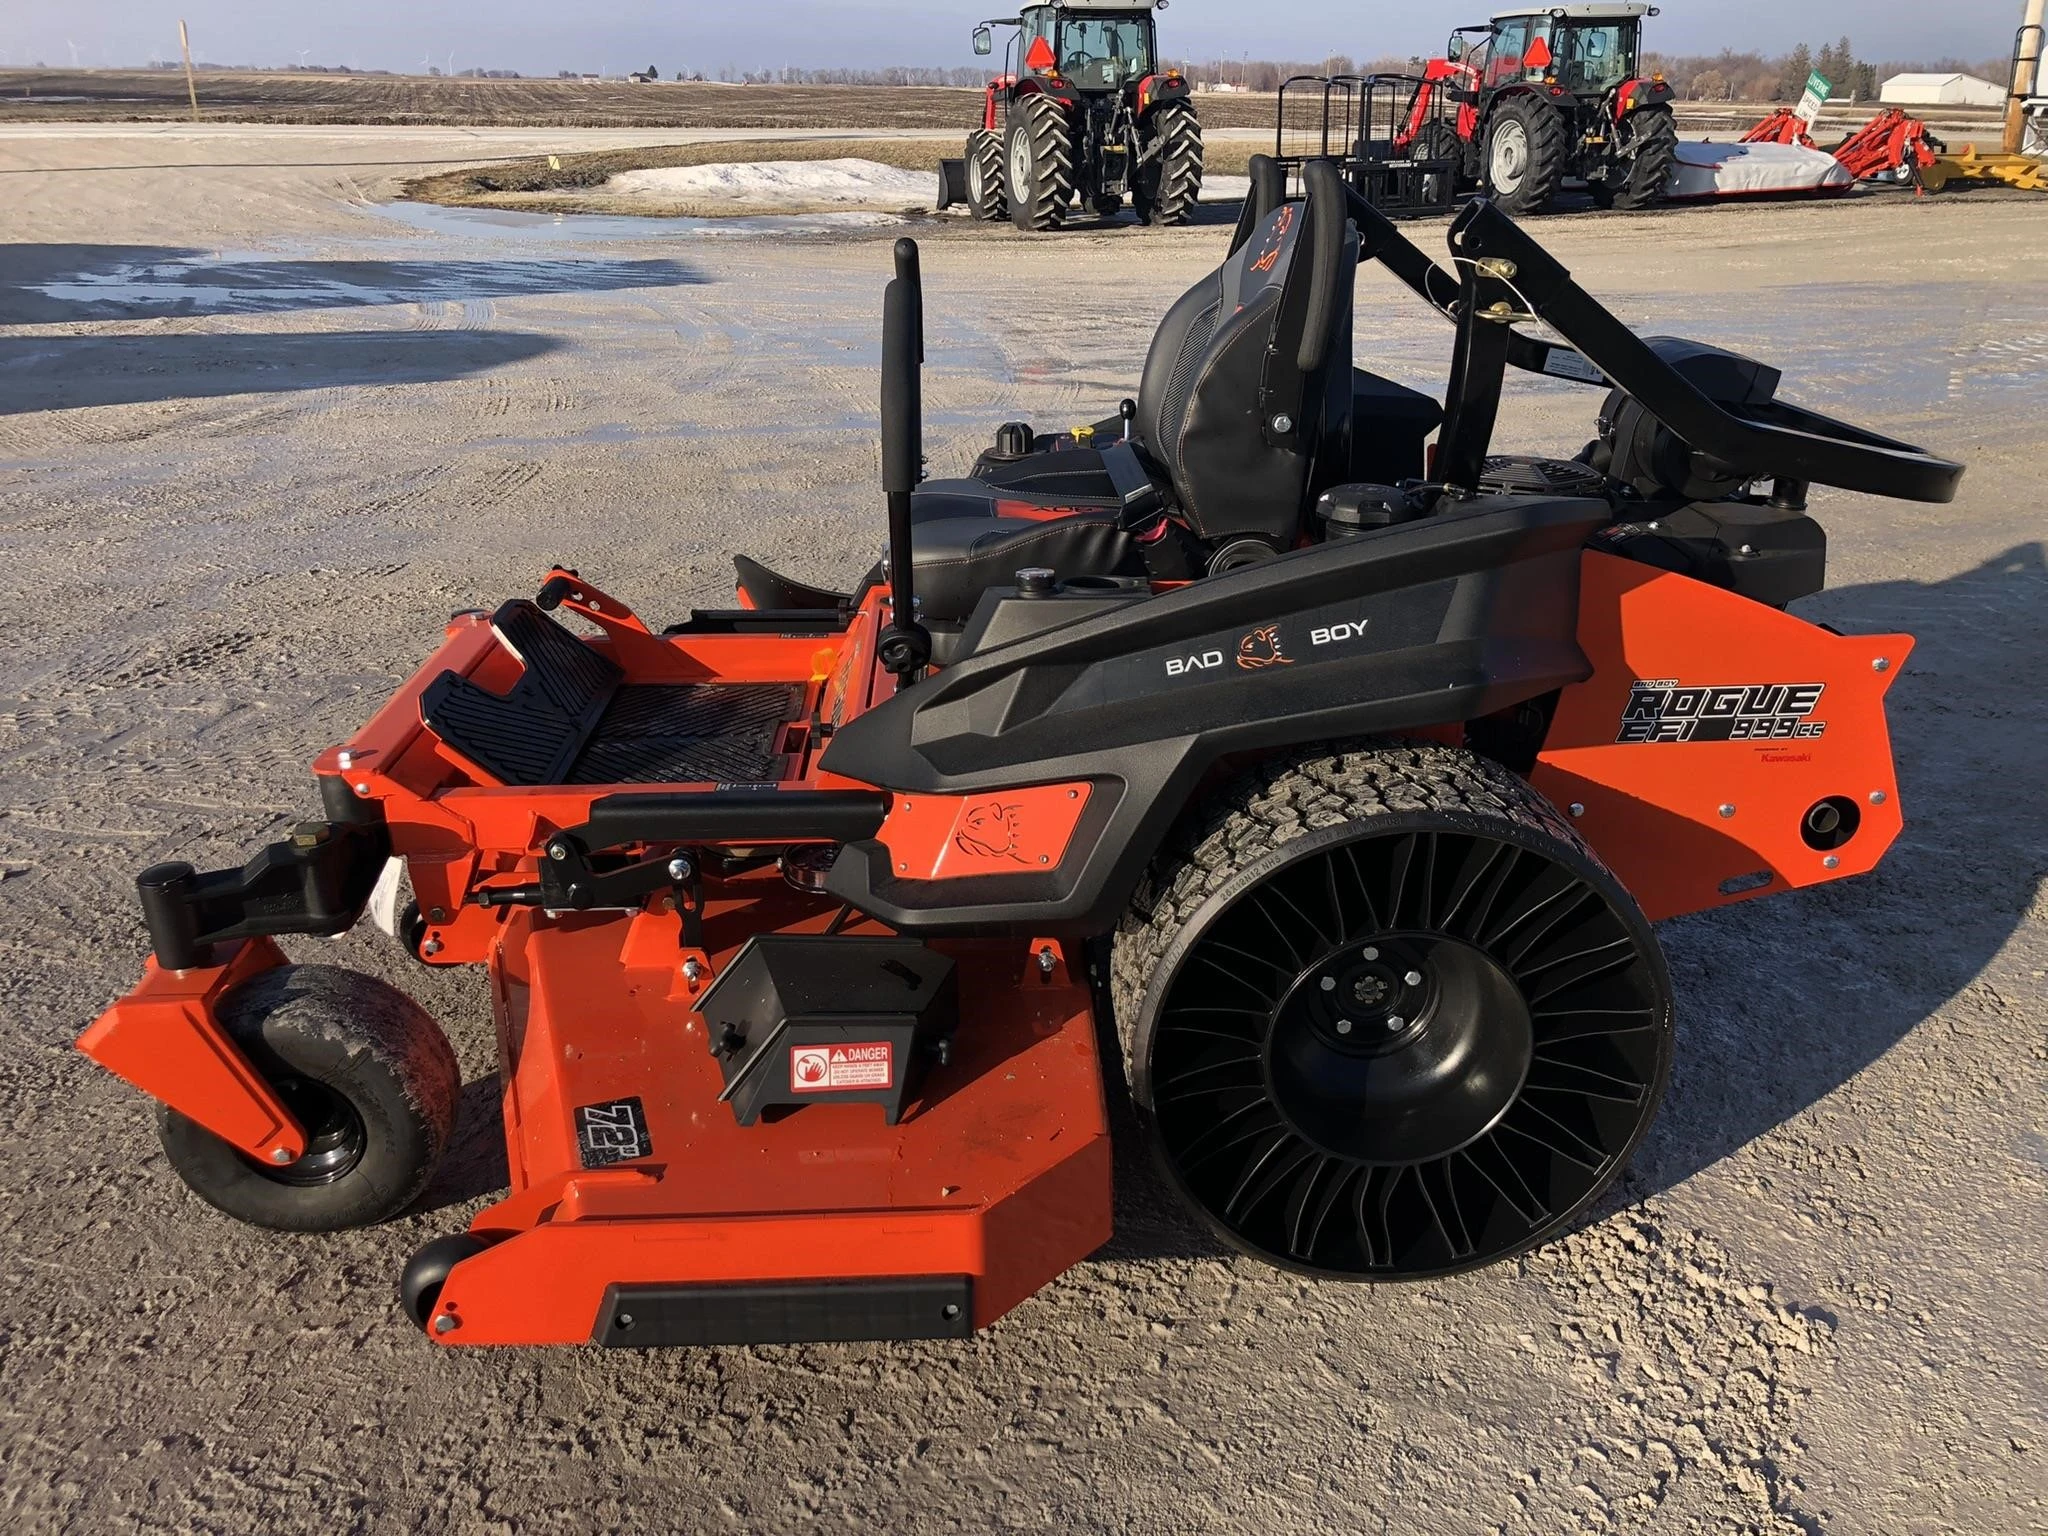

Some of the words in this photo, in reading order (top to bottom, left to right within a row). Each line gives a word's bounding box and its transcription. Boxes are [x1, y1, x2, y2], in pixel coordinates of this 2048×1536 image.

[1165, 650, 1223, 676] BAD
[1310, 619, 1369, 645] BOY
[1622, 684, 1826, 720] ROGUE
[1615, 719, 1698, 743] EFI
[1760, 753, 1811, 763] Kawasaki
[1261, 854, 1281, 871] NHS
[848, 1047, 888, 1061] DANGER
